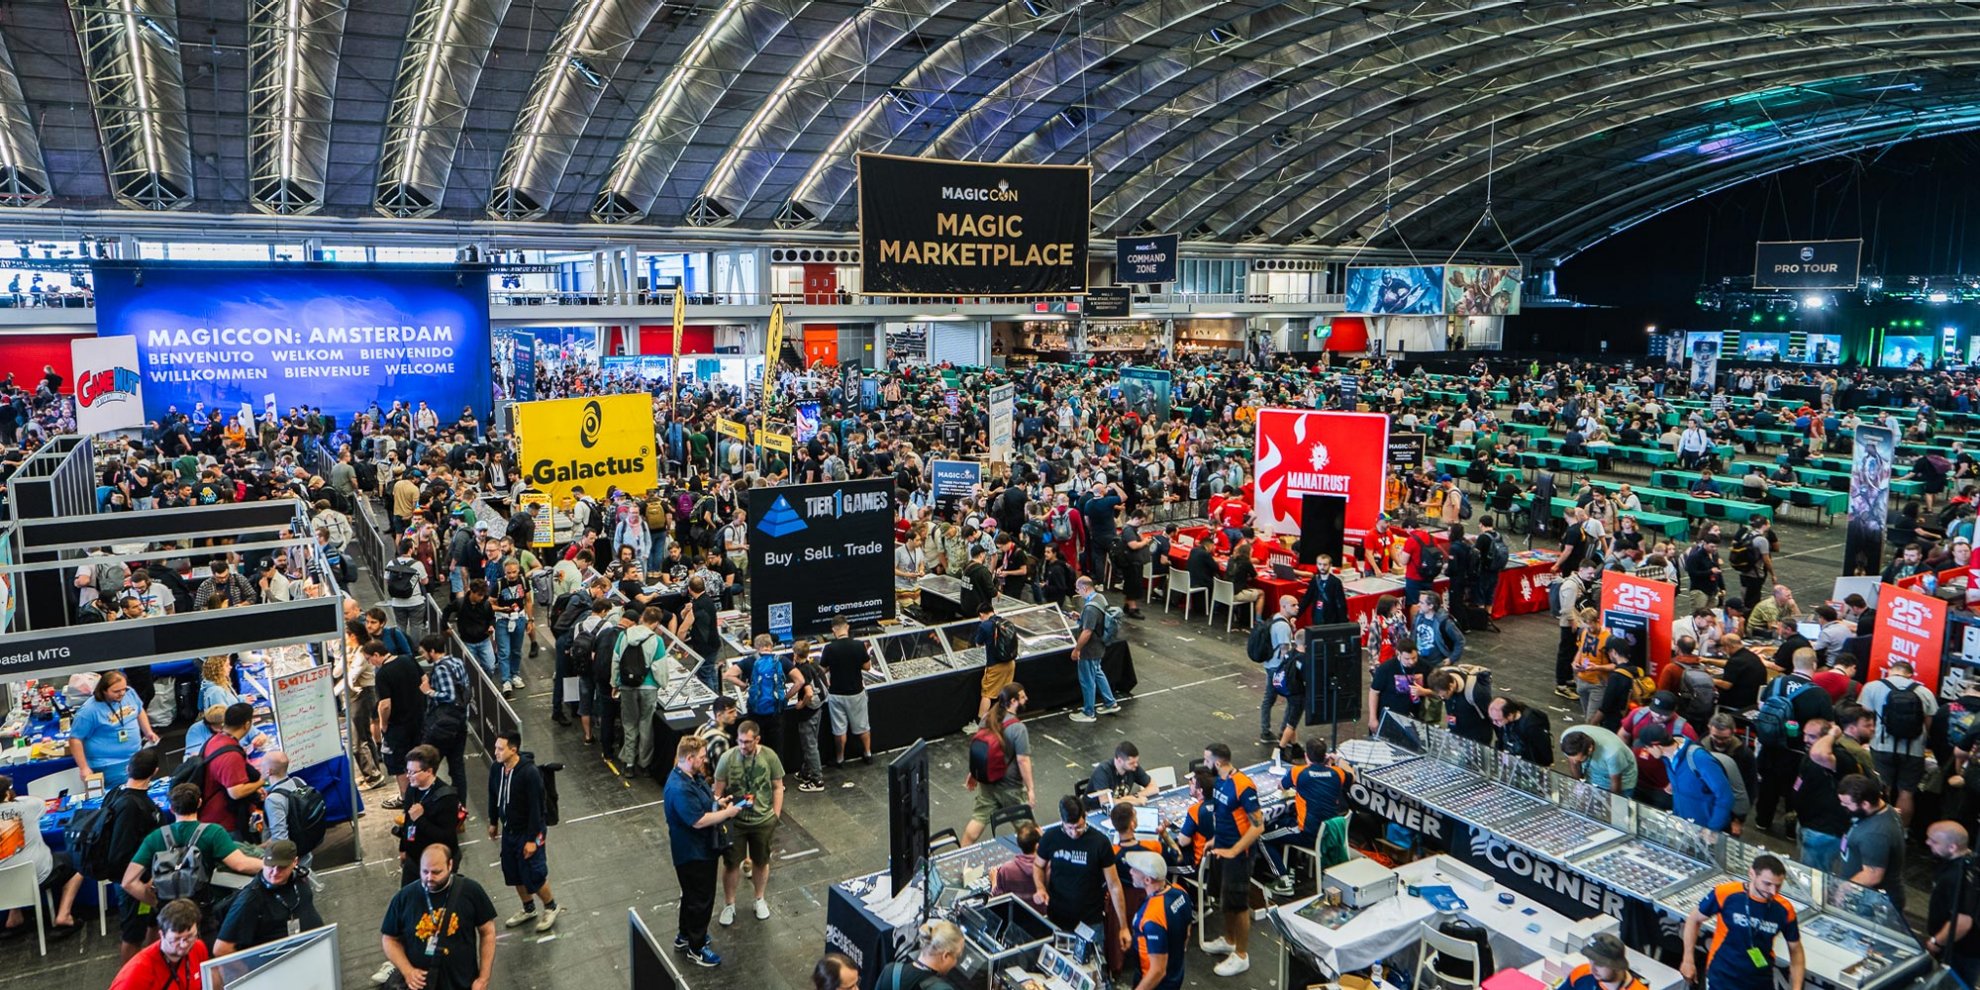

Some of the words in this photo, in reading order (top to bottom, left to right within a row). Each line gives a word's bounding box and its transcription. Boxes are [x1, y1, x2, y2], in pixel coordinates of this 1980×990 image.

[937, 212, 1023, 238] MAGIC
[879, 239, 1074, 266] MARKETPLACE
[1127, 252, 1166, 264] COMMAND
[1136, 264, 1157, 273] ZONE
[1774, 264, 1799, 273] PRO
[1803, 263, 1838, 273] TOUR
[147, 328, 301, 347] MAGICCON:
[309, 326, 453, 344] AMSTERDAM
[148, 351, 254, 365] BENVENUTO
[271, 349, 343, 362] WELKOM
[360, 347, 454, 360] BIENVENIDO
[150, 368, 268, 383] WILLKOMMEN
[284, 365, 370, 379] BIENVENUE
[385, 363, 454, 376] WELCOME
[532, 456, 645, 485] Galactus
[1287, 471, 1351, 492] MANATRUST
[843, 491, 888, 513] GAMES
[765, 551, 792, 567] Buy
[804, 545, 833, 561] Sell
[844, 541, 883, 557] Trade
[0, 651, 34, 666] astal
[37, 647, 71, 661] MTG
[1891, 635, 1920, 657] BUY
[1350, 783, 1442, 840] ORNER
[1485, 838, 1625, 921] CORNER
